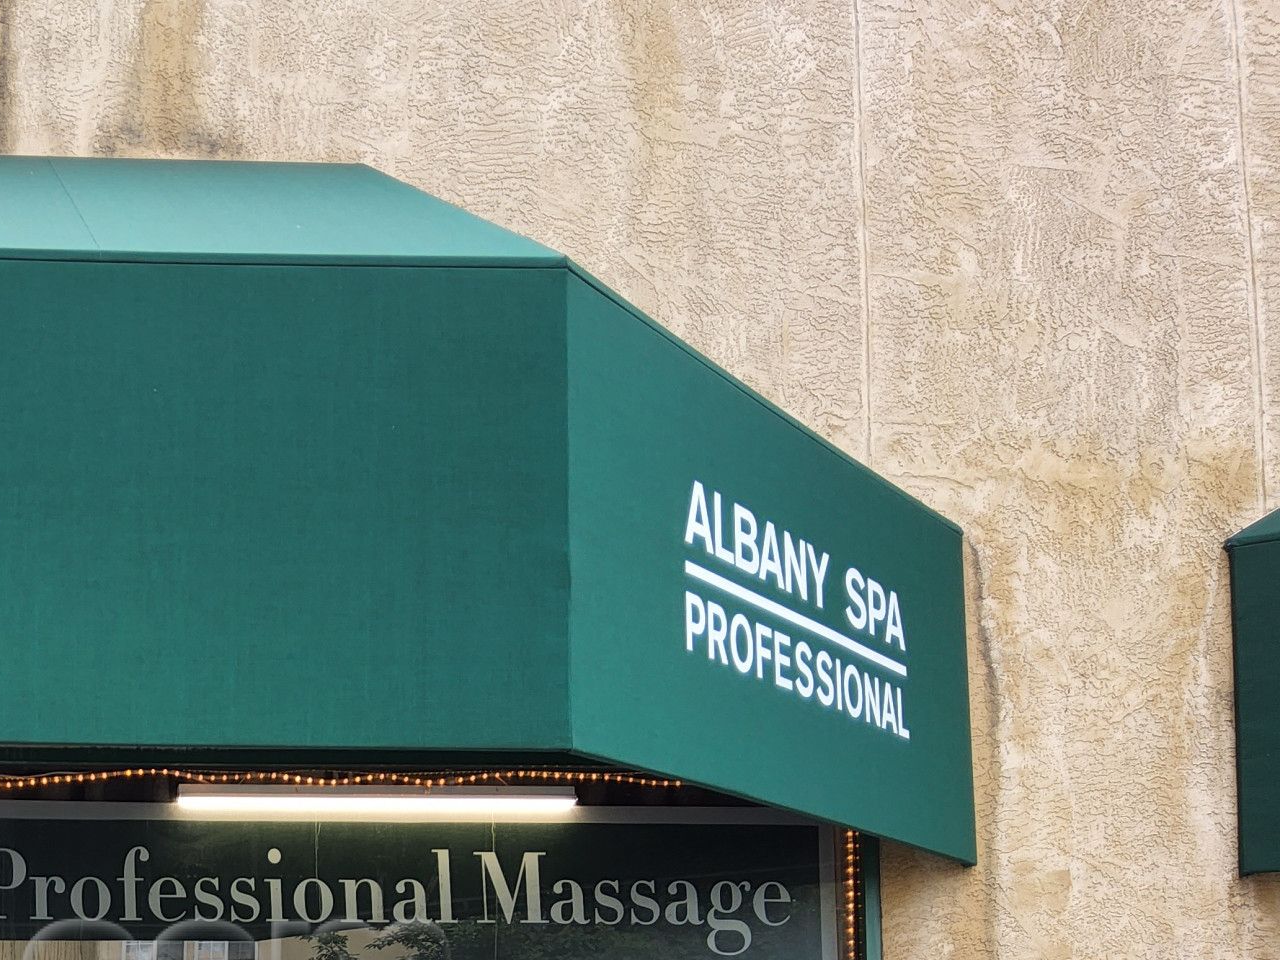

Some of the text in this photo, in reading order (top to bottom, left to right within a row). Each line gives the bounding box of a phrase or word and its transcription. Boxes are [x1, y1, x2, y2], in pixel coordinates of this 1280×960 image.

[685, 480, 907, 651] ALBANY SPA
[685, 590, 910, 739] PROFESSIONAL
[473, 851, 791, 956] Massage
